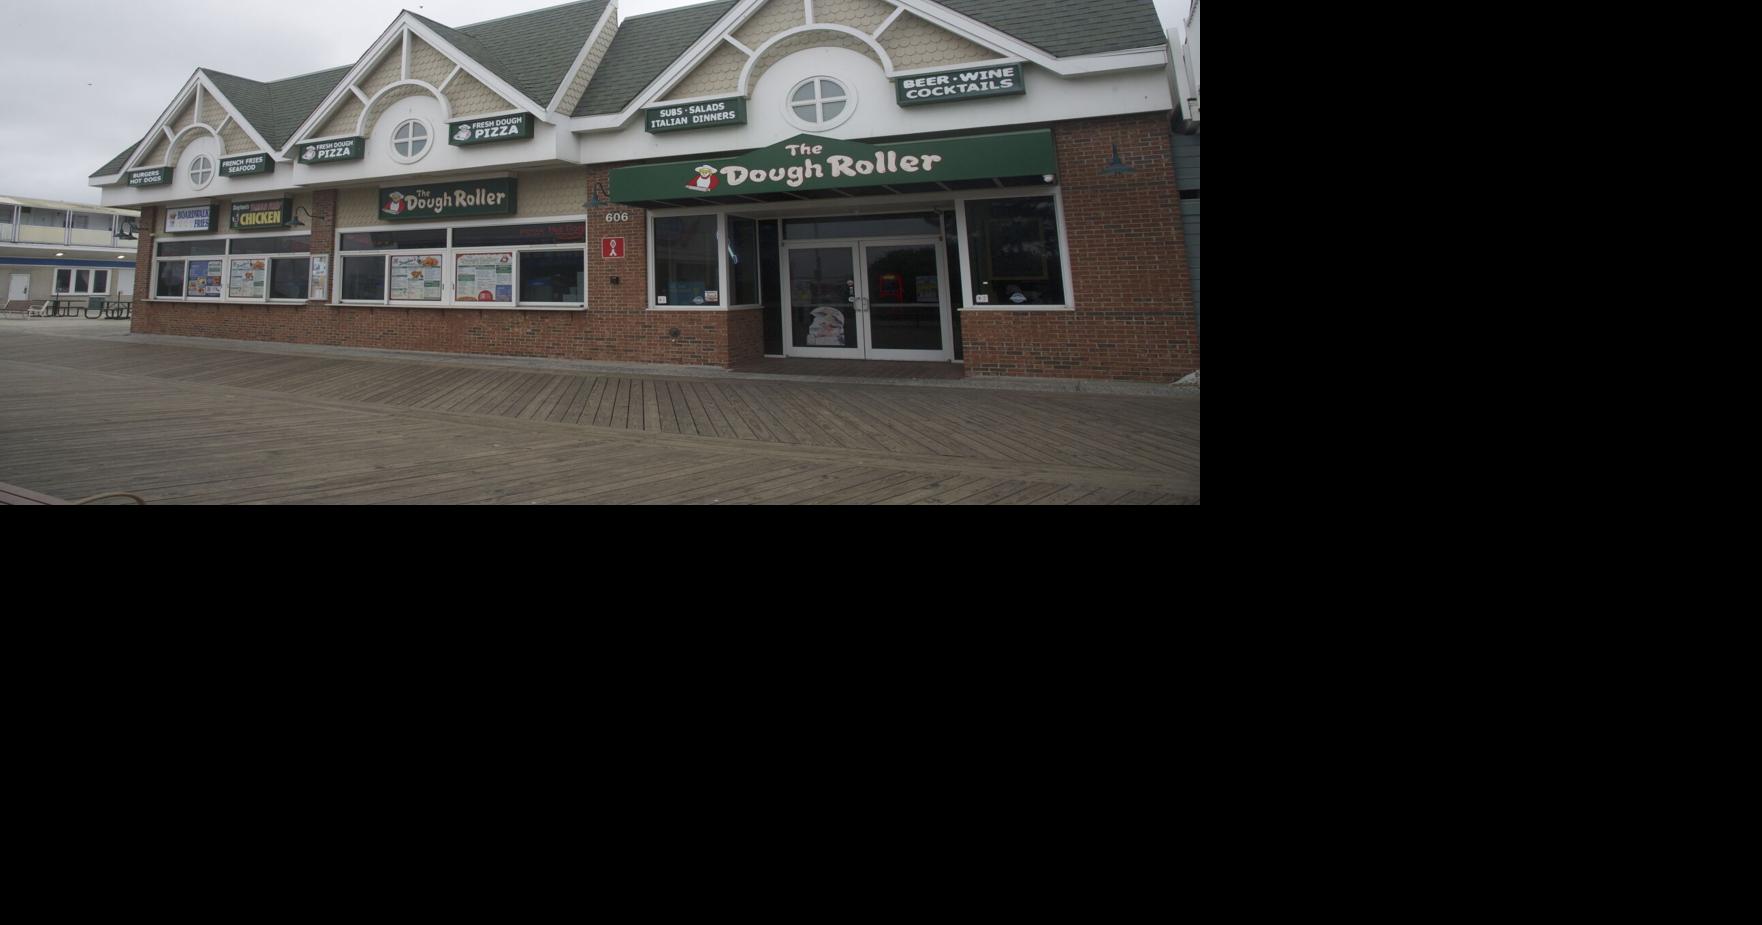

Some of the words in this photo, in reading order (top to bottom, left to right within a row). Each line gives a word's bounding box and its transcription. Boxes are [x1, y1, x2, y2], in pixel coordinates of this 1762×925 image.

[903, 75, 949, 89] BEER
[960, 67, 1015, 82] WINE
[906, 79, 1014, 99] COCKTAILS
[660, 107, 683, 118] SUBS
[689, 102, 725, 114] SALADS
[472, 120, 494, 129] FRESH
[496, 116, 522, 127] DOUGH
[651, 116, 688, 128] ITALIAN
[692, 111, 736, 123] DINNERS
[474, 126, 519, 139] PIZZA
[334, 140, 354, 148] DOUGH
[785, 143, 823, 156] The
[318, 147, 350, 159] PIZZA
[222, 158, 244, 167] FRENCH
[228, 164, 256, 173] SEAFOOD
[720, 158, 824, 187] Dough
[826, 150, 942, 178] Roller
[416, 189, 431, 198] The
[405, 191, 453, 213] Dough
[454, 189, 506, 208] Roller
[239, 210, 281, 225] CHICKEN
[605, 212, 629, 222] 606
